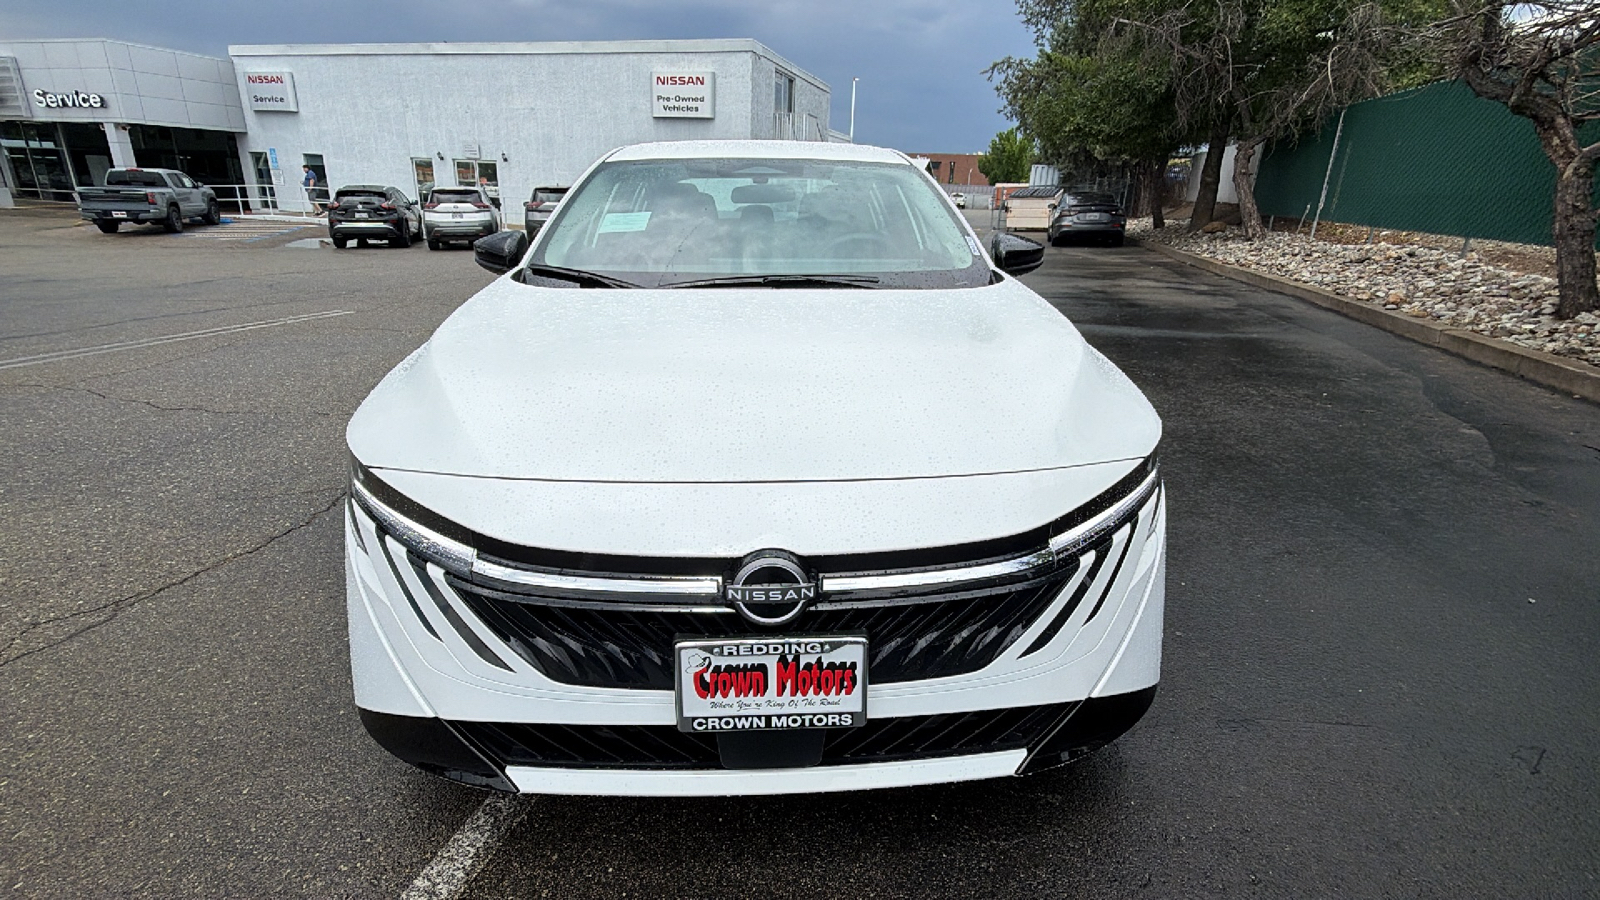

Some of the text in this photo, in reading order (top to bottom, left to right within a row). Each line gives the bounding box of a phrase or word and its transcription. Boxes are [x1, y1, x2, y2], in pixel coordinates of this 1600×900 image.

[247, 75, 284, 84] NISSAN
[656, 76, 705, 86] NISSAN
[33, 88, 102, 108] Service
[253, 94, 285, 103] Service
[656, 94, 705, 103] Pre-Owned
[662, 104, 699, 112] Vehicles
[727, 586, 815, 601] NISSAN
[722, 643, 822, 656] REDDING
[693, 658, 857, 700] Crown Motors
[709, 701, 734, 709] Where
[764, 699, 786, 709] King
[787, 699, 799, 708] Of
[801, 698, 816, 706] The
[818, 697, 841, 706] Road
[692, 714, 853, 731] CROWN MOTORS
